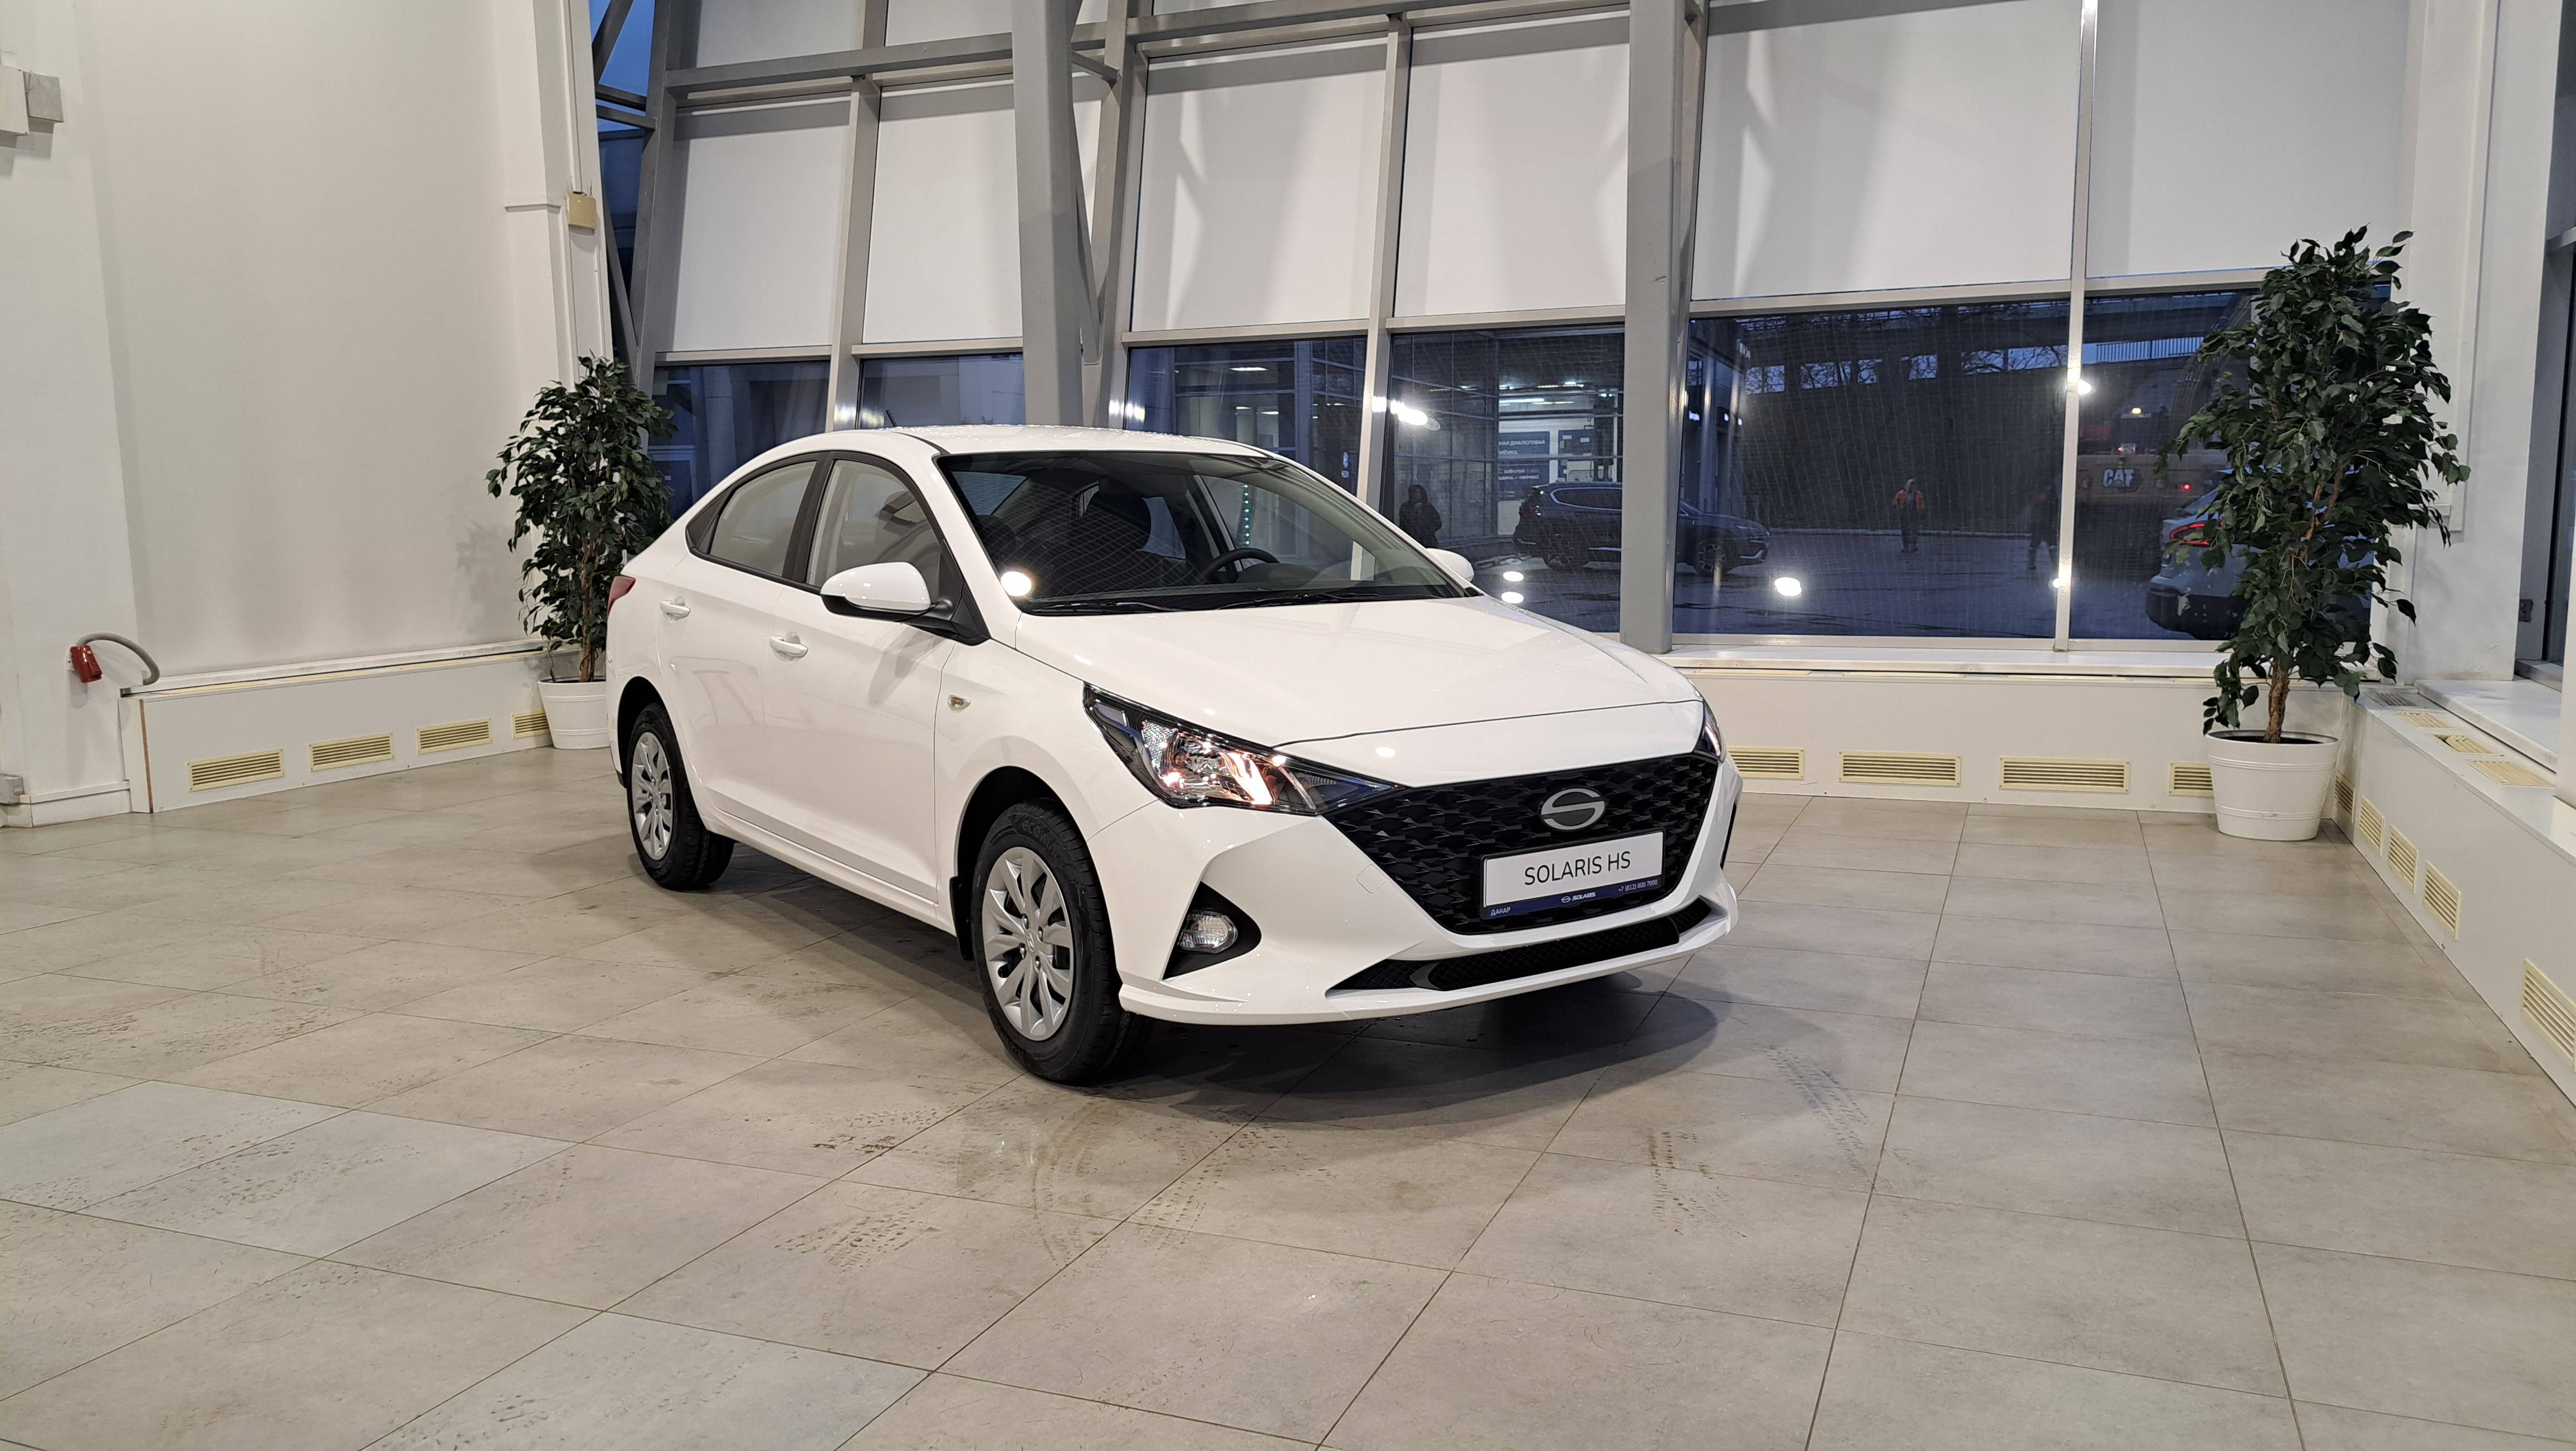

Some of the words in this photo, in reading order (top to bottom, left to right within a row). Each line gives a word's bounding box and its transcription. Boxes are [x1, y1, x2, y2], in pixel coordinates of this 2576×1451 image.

[2103, 469, 2134, 488] CAT
[1524, 856, 1602, 885] SOLARIS
[1608, 851, 1631, 872] HS
[1572, 892, 1596, 900] SOLARIS
[1490, 907, 1511, 917] ДАКАР
